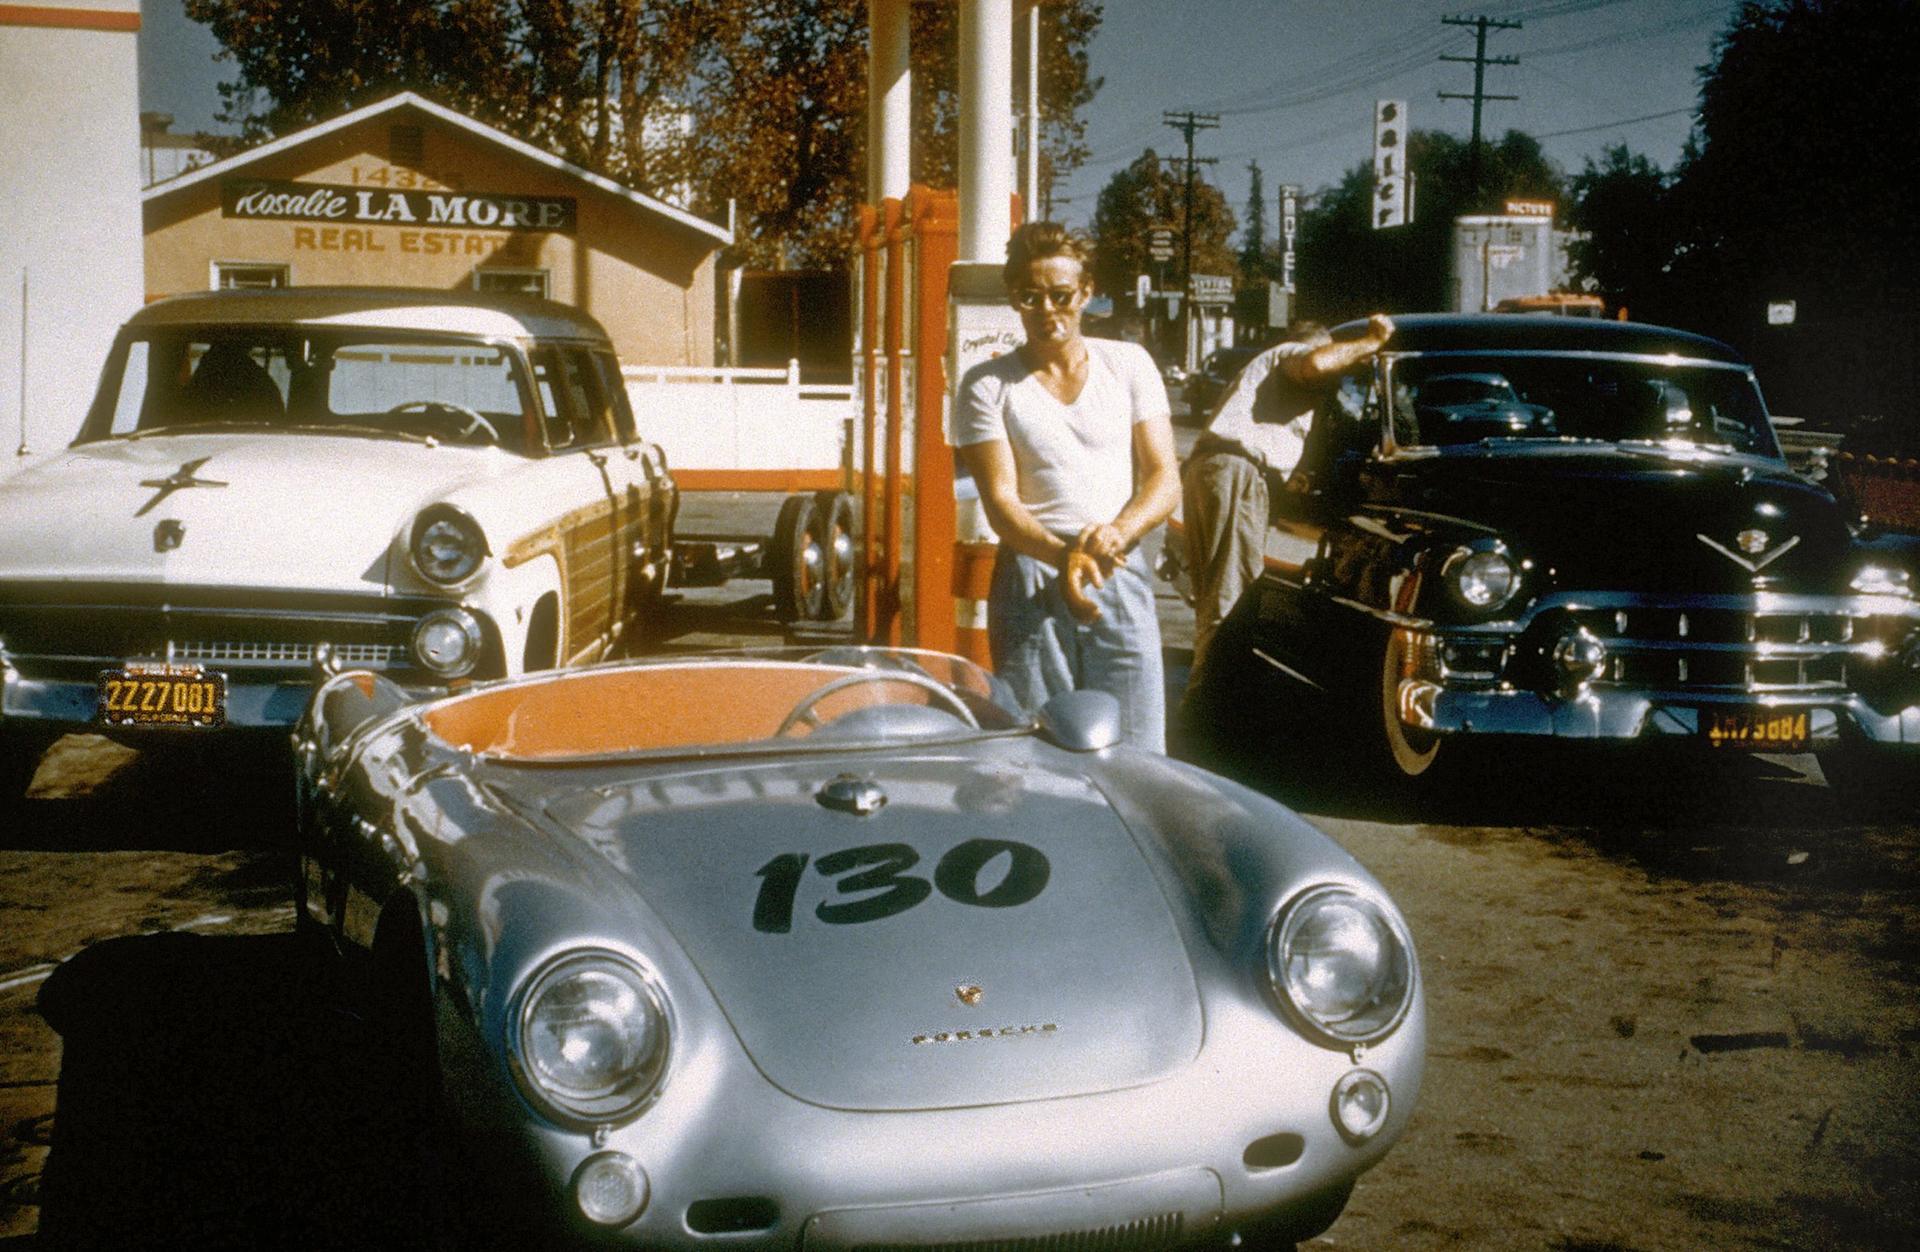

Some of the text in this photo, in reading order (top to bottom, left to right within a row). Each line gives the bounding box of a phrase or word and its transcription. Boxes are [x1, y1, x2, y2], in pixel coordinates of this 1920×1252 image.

[355, 192, 417, 222] LA
[427, 196, 565, 229] MORE
[295, 227, 386, 252] REAL
[752, 838, 1051, 934] 130
